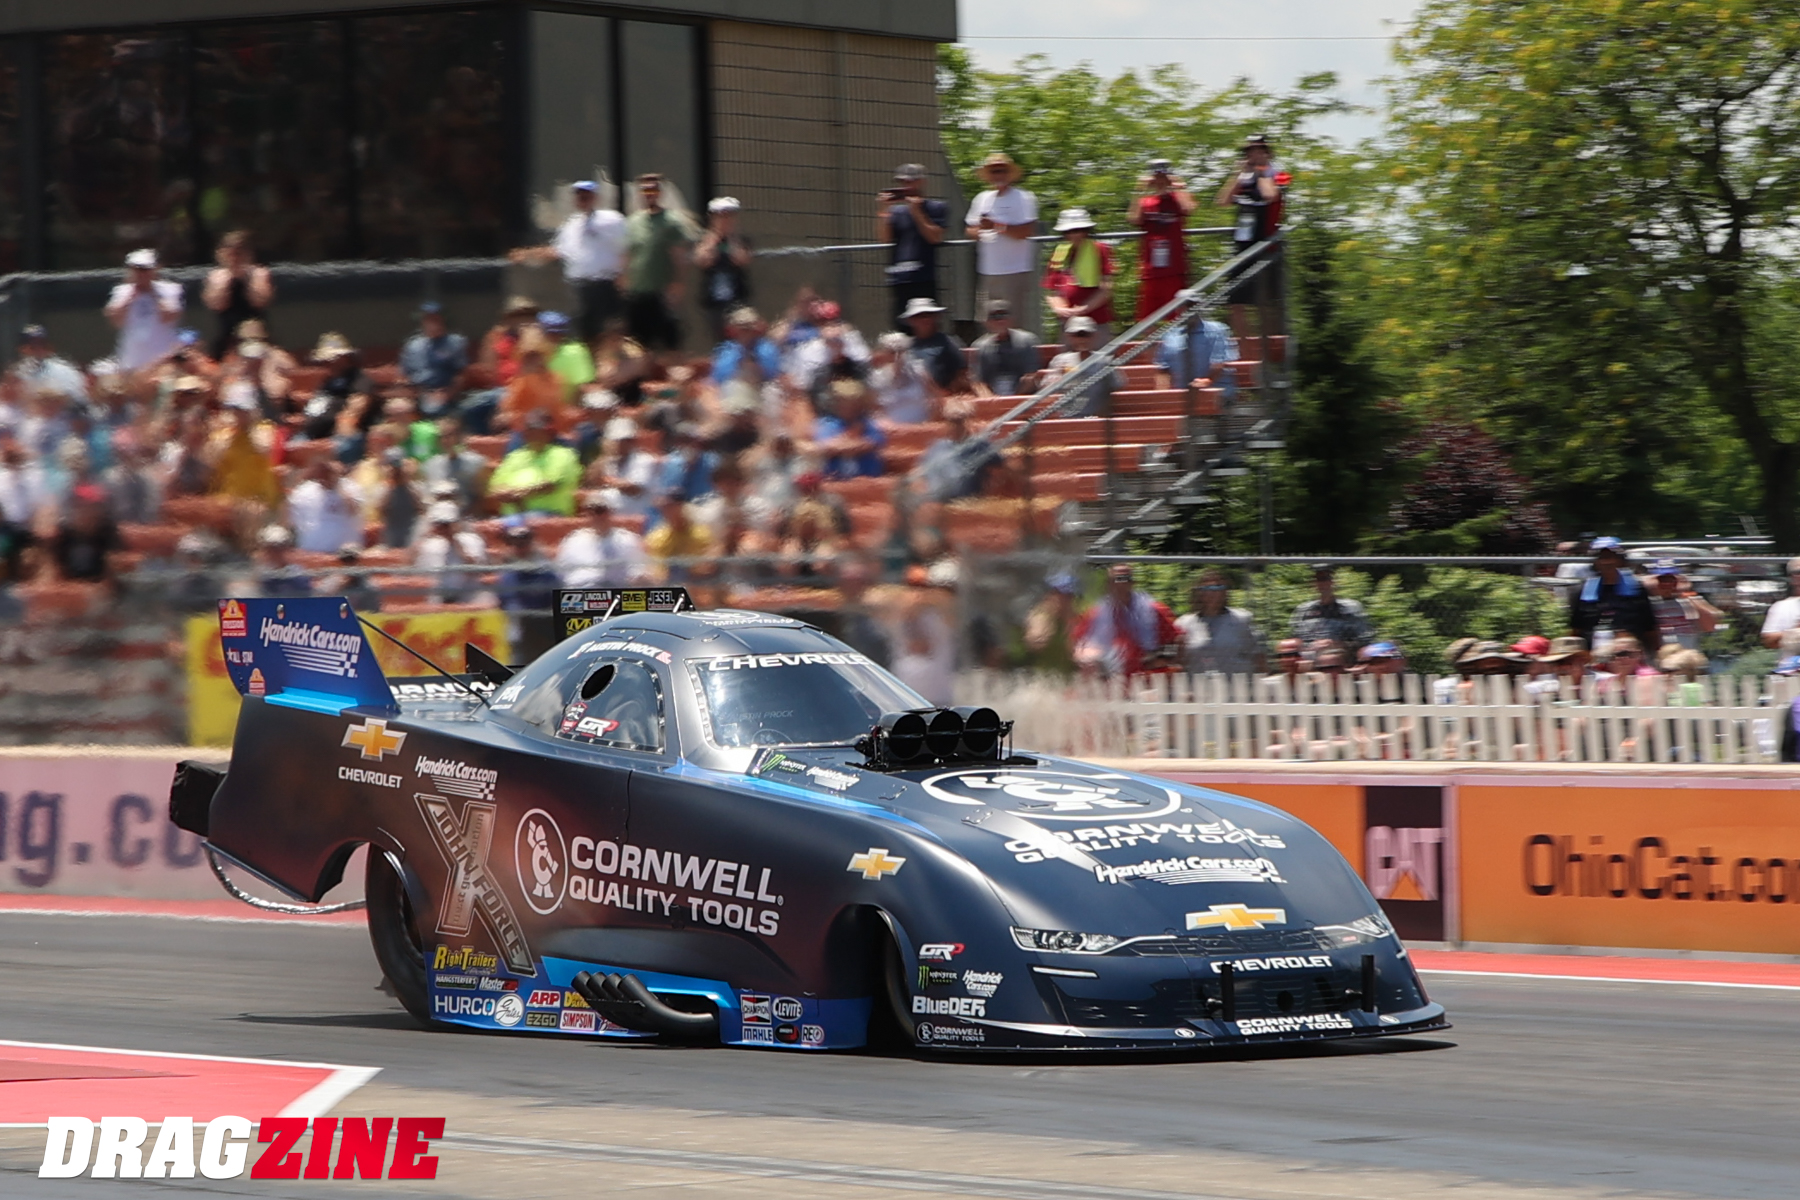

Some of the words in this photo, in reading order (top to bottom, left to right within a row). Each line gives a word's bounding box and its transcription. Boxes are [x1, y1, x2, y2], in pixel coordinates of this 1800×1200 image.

[648, 592, 675, 605] JESEL
[621, 642, 663, 658] PROCK
[338, 766, 403, 789] CHEVROLET
[1176, 830, 1287, 849] TOOLS
[571, 836, 777, 904] CORNWELL
[1523, 834, 1800, 903] OhioCat.co
[433, 809, 479, 875] JOHN
[472, 873, 522, 960] FORCE
[568, 875, 677, 917] QUALITY
[687, 896, 780, 936] TOOLS
[1210, 955, 1333, 974] CHEVROLET
[962, 969, 1003, 985] Hendrick
[435, 995, 496, 1016] HURCO
[529, 991, 560, 1006] ARP
[912, 995, 987, 1017] BlueDEF
[743, 1004, 769, 1015] CHAMPION
[562, 1012, 594, 1029] SIMPSON
[1236, 1013, 1346, 1028] CORNWELL
[1240, 1024, 1301, 1036] QUALITY
[1306, 1020, 1353, 1030] TOOLS
[933, 1033, 960, 1041] QUALITY
[934, 1026, 985, 1036] CORNWELL
